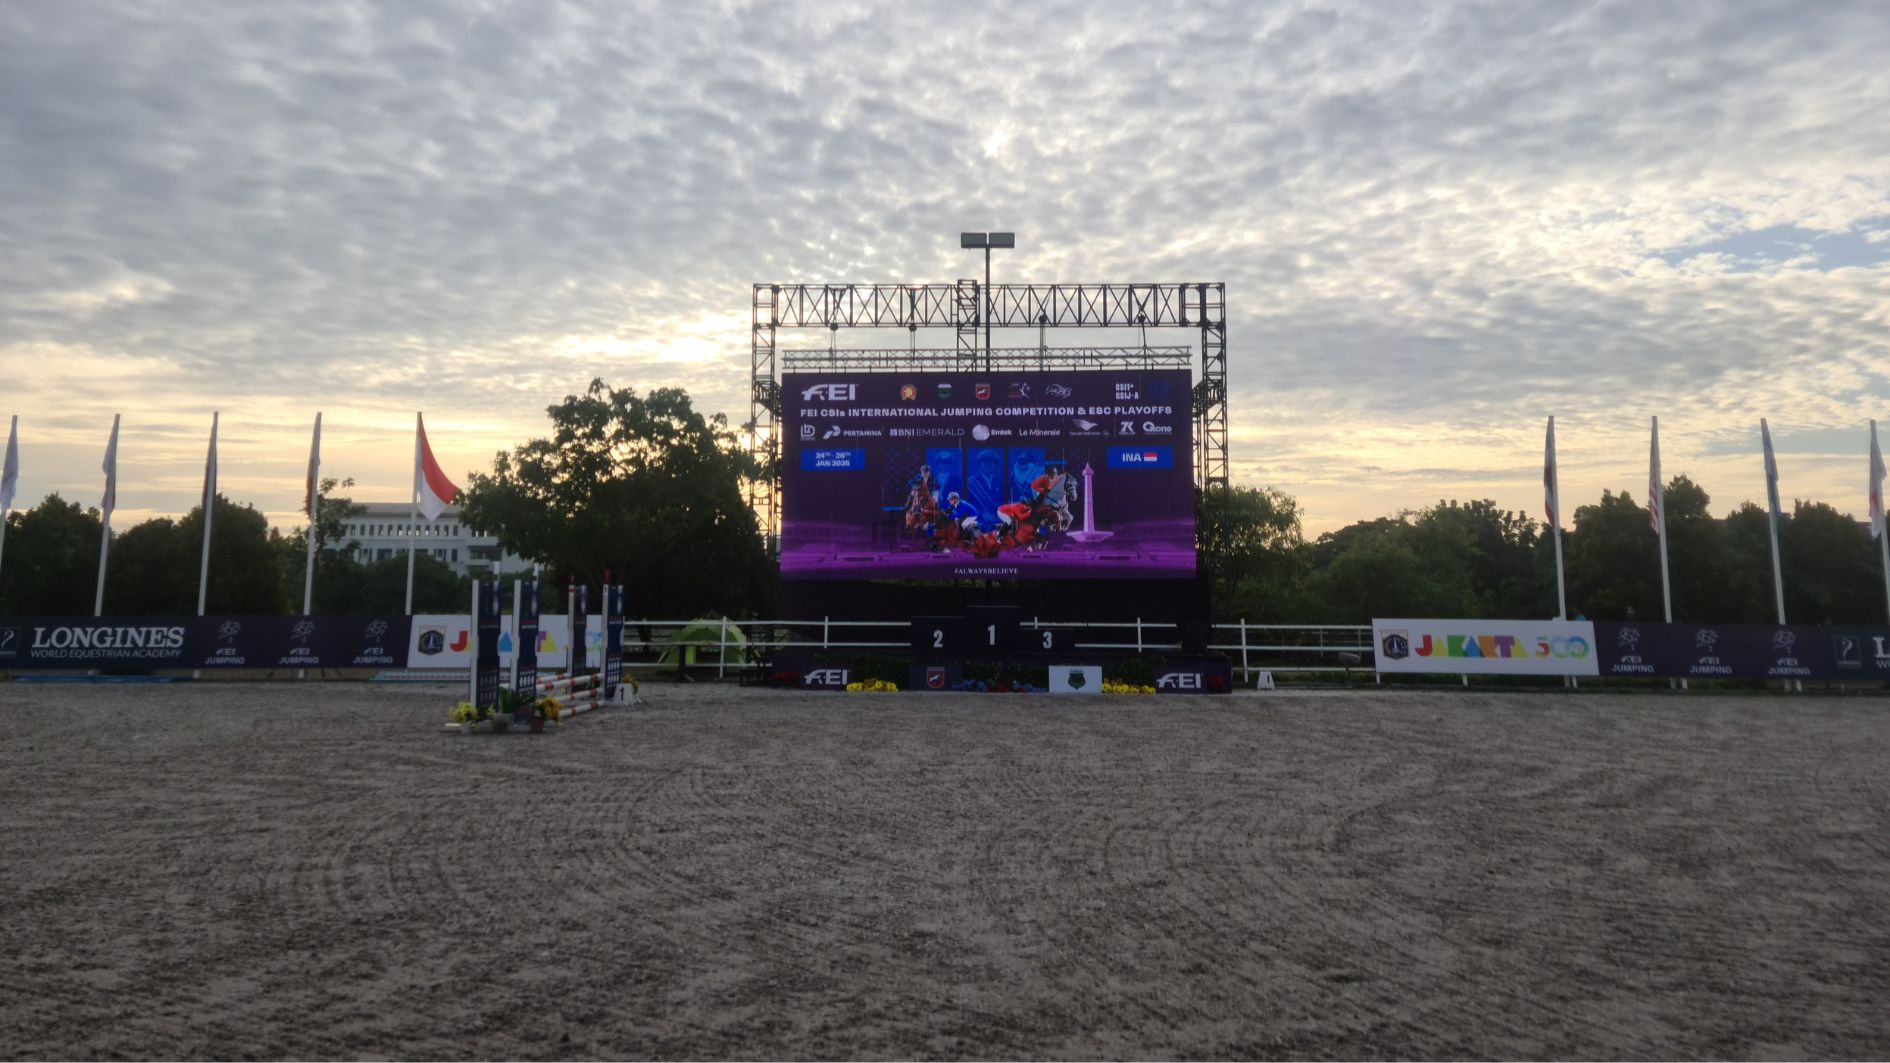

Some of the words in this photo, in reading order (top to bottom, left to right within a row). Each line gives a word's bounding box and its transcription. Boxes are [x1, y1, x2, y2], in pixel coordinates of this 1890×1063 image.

[801, 384, 856, 400] FEI
[800, 408, 818, 417] FEI
[848, 407, 938, 417] INTERNATIONAL
[940, 407, 993, 416] JUMPING
[995, 406, 1075, 416] COMPETITION
[1077, 406, 1086, 415] &
[1088, 406, 1111, 415] ESC
[1114, 405, 1172, 415] PLAYOFFS
[916, 428, 965, 437] EMERALD
[1019, 428, 1028, 436] Le
[1029, 428, 1061, 436] Minerale
[1122, 452, 1142, 462] INA
[954, 567, 1019, 575] #ALWAYSBELIEVE
[31, 626, 185, 649] LONGINES
[933, 629, 944, 649] 2
[987, 624, 996, 646] 1
[1042, 631, 1053, 650] 3
[1415, 634, 1530, 658] JAKARTA
[31, 649, 68, 659] WORLD
[69, 649, 130, 660] EQUESTRIAN
[130, 649, 182, 659] ACADEMY
[204, 656, 246, 665] JUMPING
[278, 656, 320, 665] JUMPING
[352, 656, 394, 664] JUMPING
[1611, 664, 1654, 673] JUMPING
[1689, 665, 1733, 674] JUMPING
[1767, 666, 1811, 676] JUMPING
[803, 669, 848, 685] FEI
[1156, 673, 1202, 689] FEI
